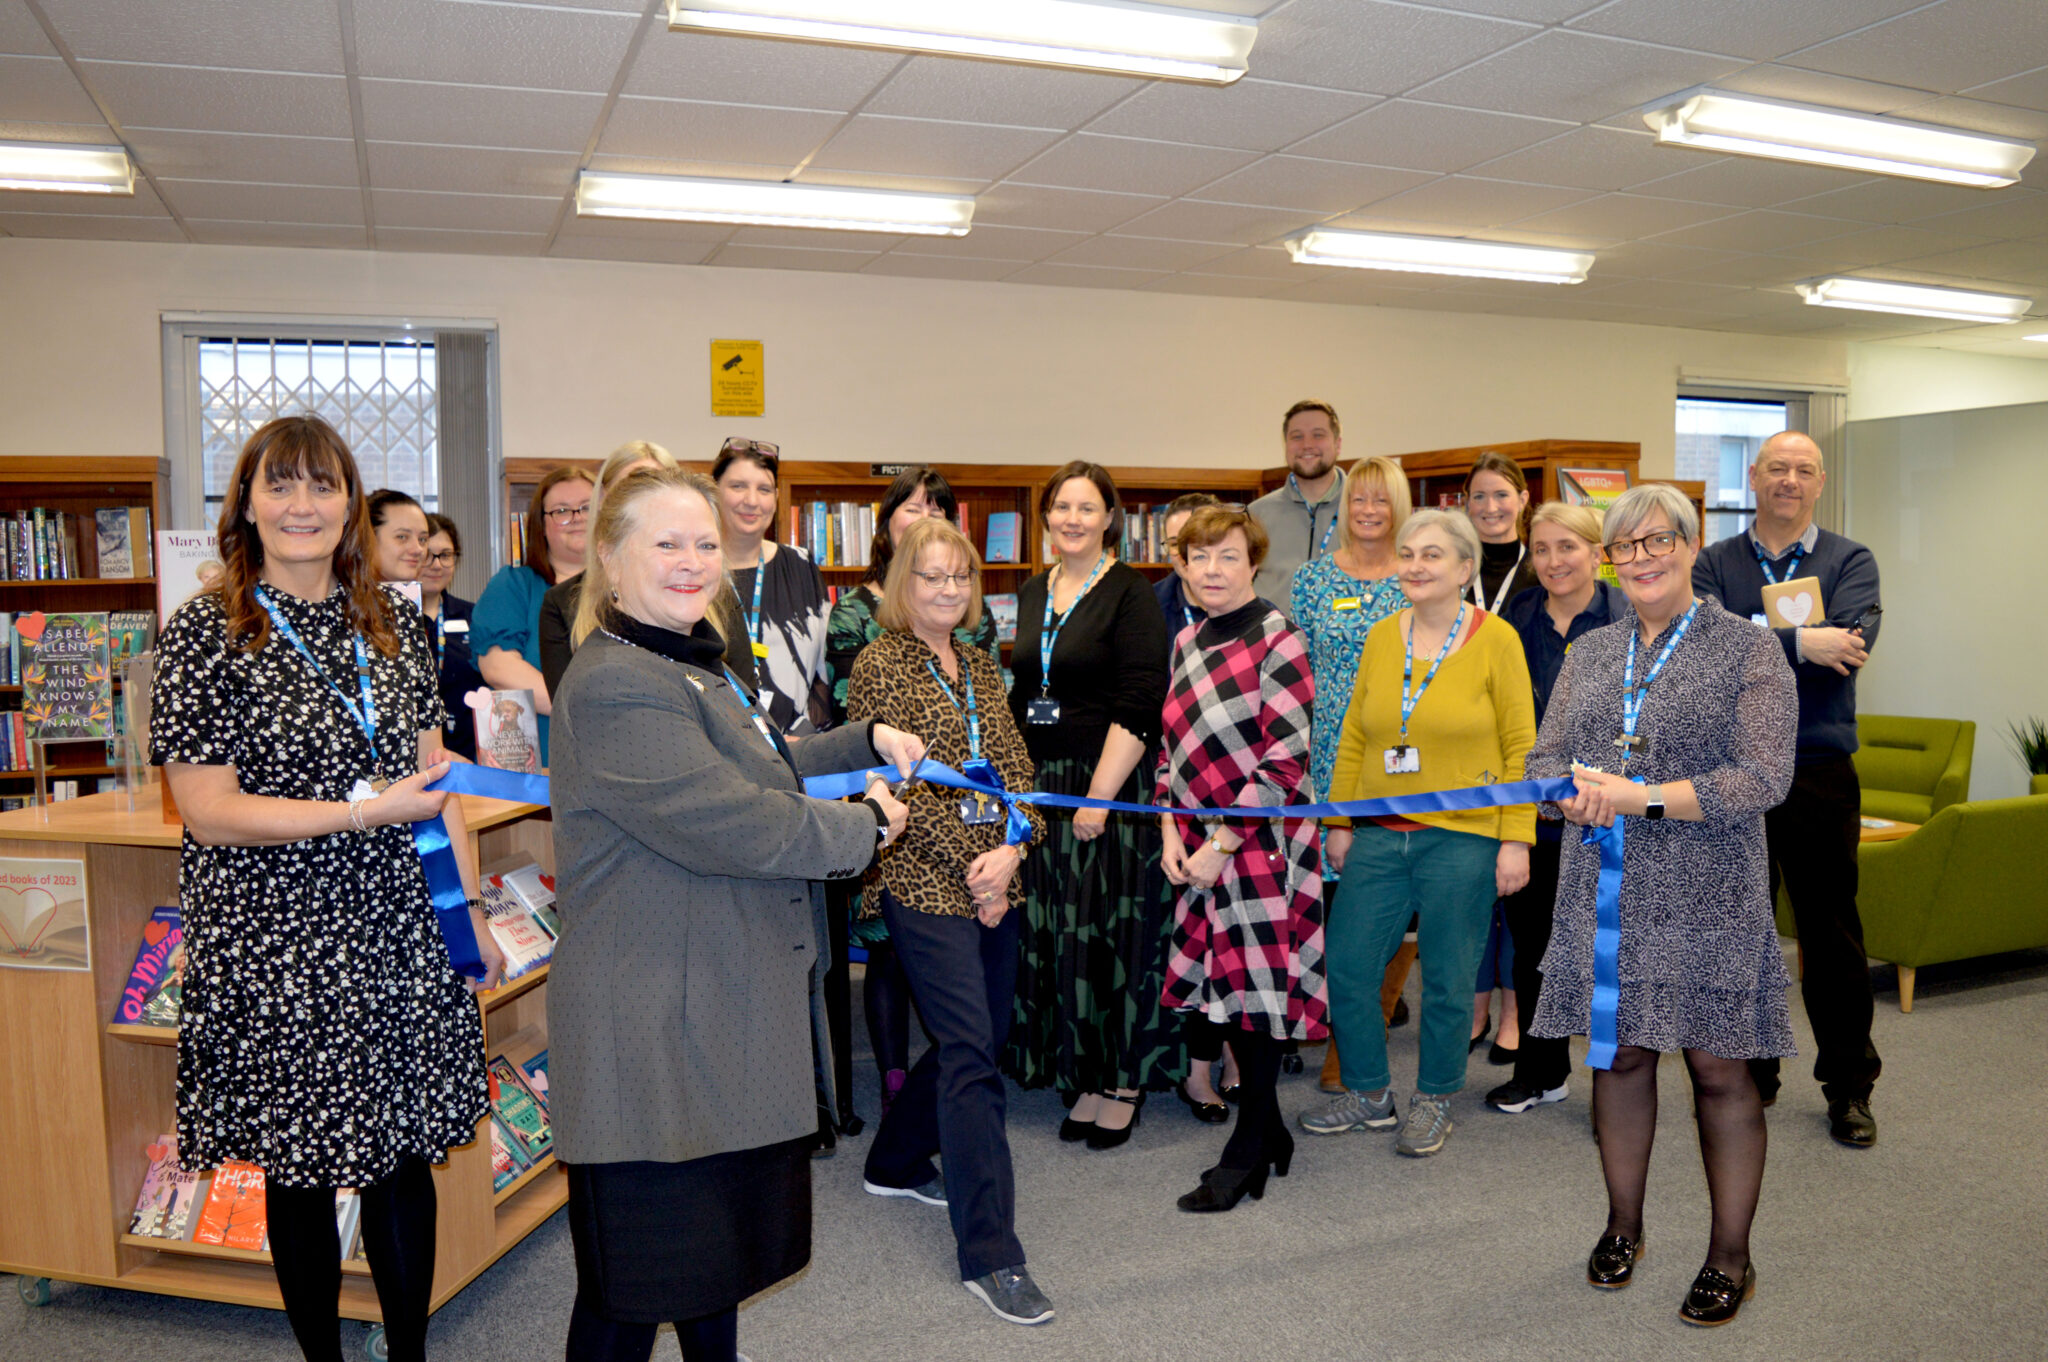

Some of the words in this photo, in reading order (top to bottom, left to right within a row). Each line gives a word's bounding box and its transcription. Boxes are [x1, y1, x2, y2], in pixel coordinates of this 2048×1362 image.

[881, 464, 912, 475] FICTI
[1579, 477, 1613, 488] LGBTQ+
[1582, 496, 1609, 506] HISTO
[168, 536, 202, 550] Mary
[1601, 566, 1616, 576] LGB
[110, 613, 152, 621] JEFFERY
[270, 611, 287, 628] NHS
[110, 622, 149, 630] DEAVER
[33, 642, 97, 652] ALLENDE
[53, 665, 79, 675] THE
[46, 678, 87, 688] WIND
[39, 691, 95, 701] KNOWS
[362, 687, 373, 703] NHS
[57, 704, 78, 714] MY
[365, 707, 376, 725] NHS
[47, 719, 89, 727] NAME
[0, 873, 8, 883] d
[10, 873, 38, 885] books
[40, 874, 51, 885] of
[53, 875, 77, 886] 2023
[132, 928, 183, 986] Miria
[123, 986, 148, 1020] Oh
[167, 1172, 195, 1184] Mate
[214, 1167, 266, 1190] THOR
